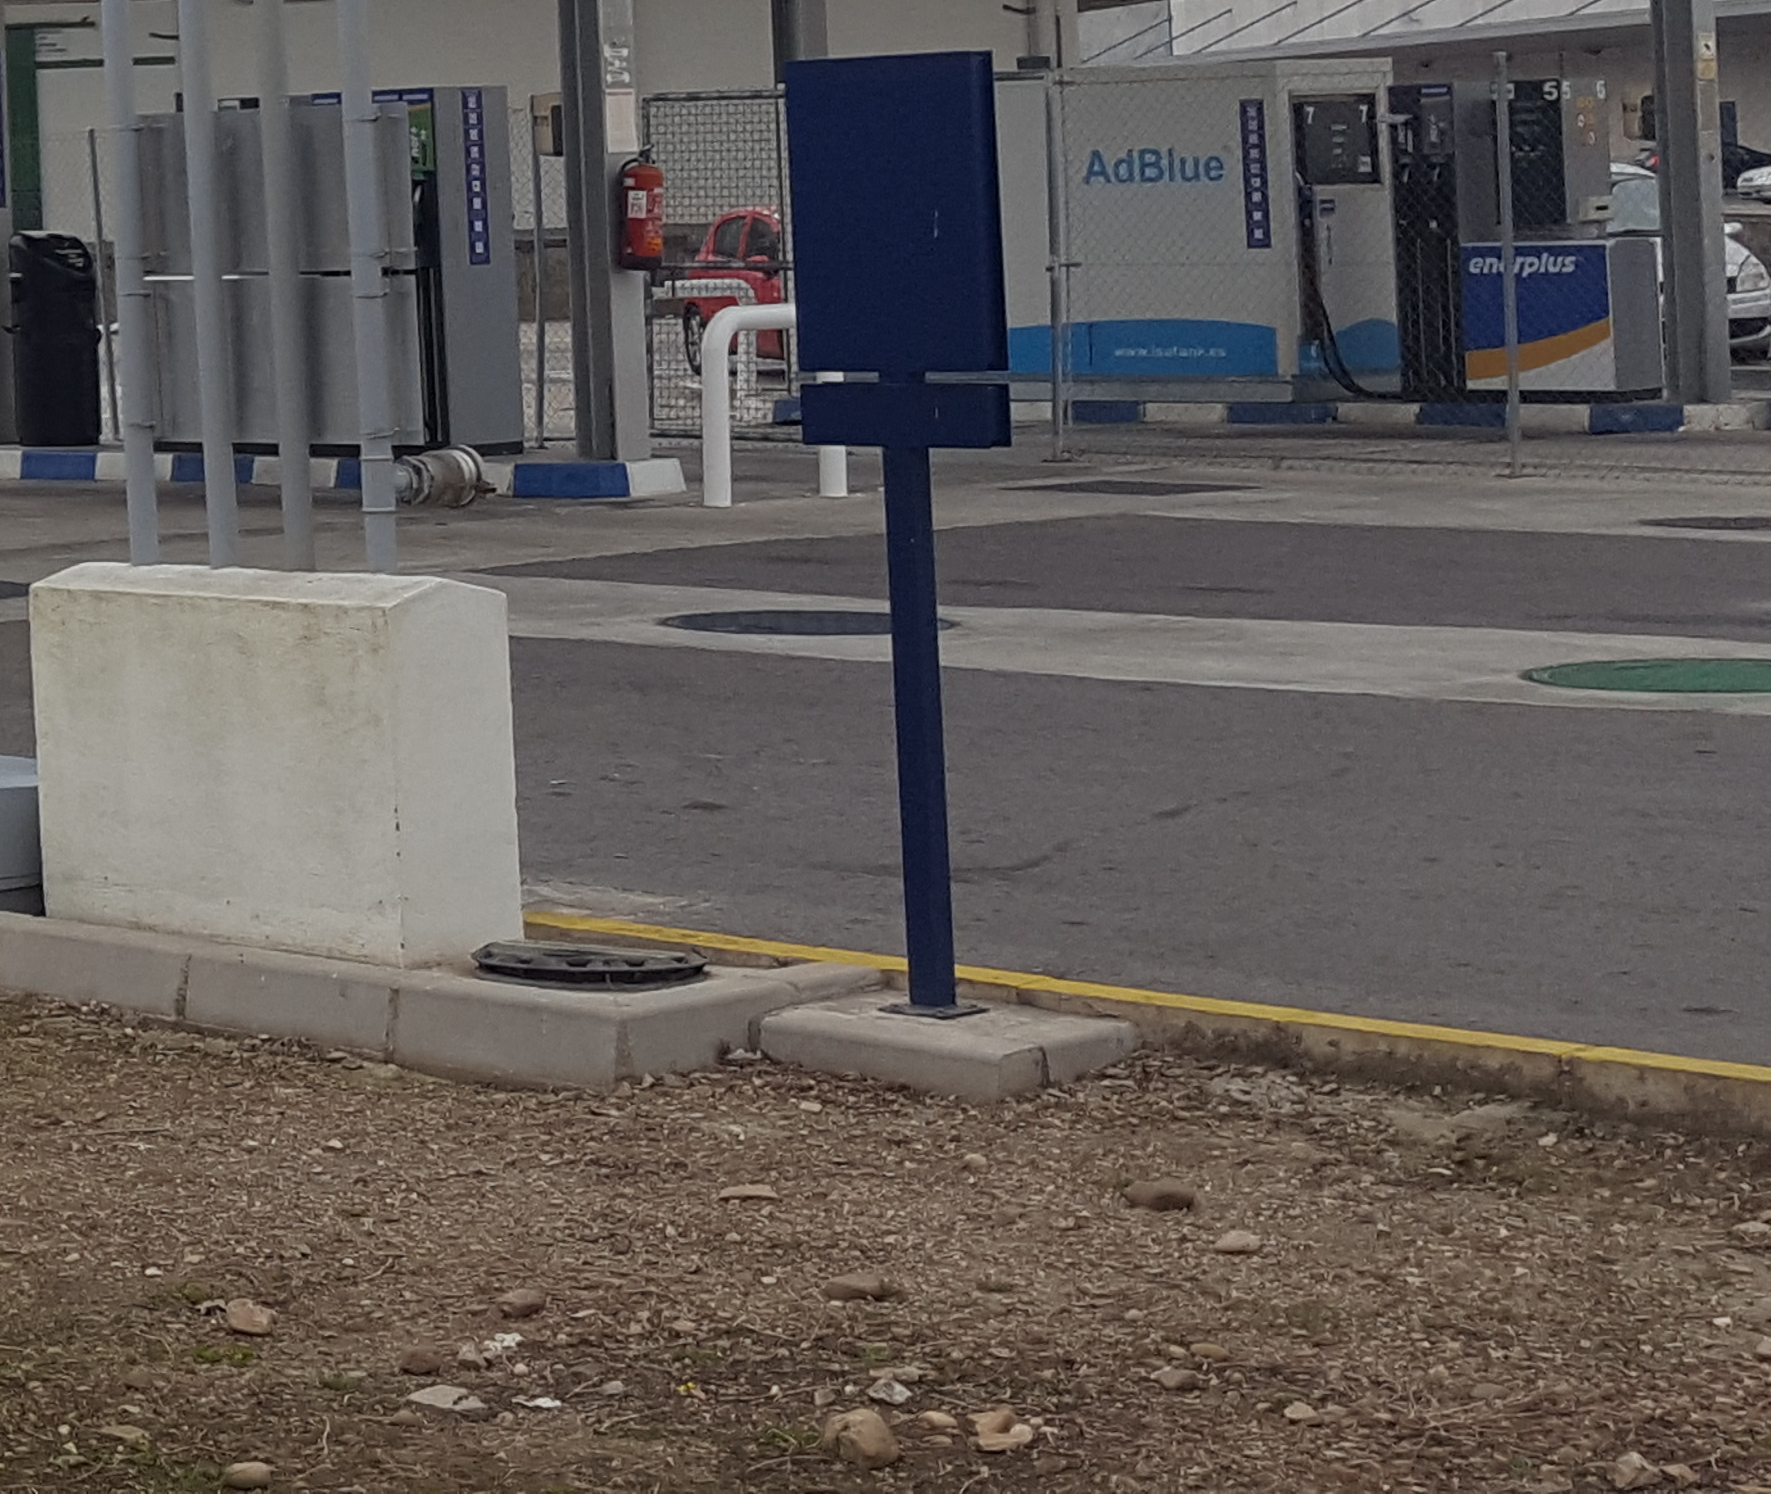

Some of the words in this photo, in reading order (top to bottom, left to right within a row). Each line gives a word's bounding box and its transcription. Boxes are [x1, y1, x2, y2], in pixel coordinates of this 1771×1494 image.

[1543, 81, 1559, 101] 5
[1305, 106, 1314, 124] 7
[1359, 105, 1368, 123] 7
[1083, 146, 1225, 185] AdBlue
